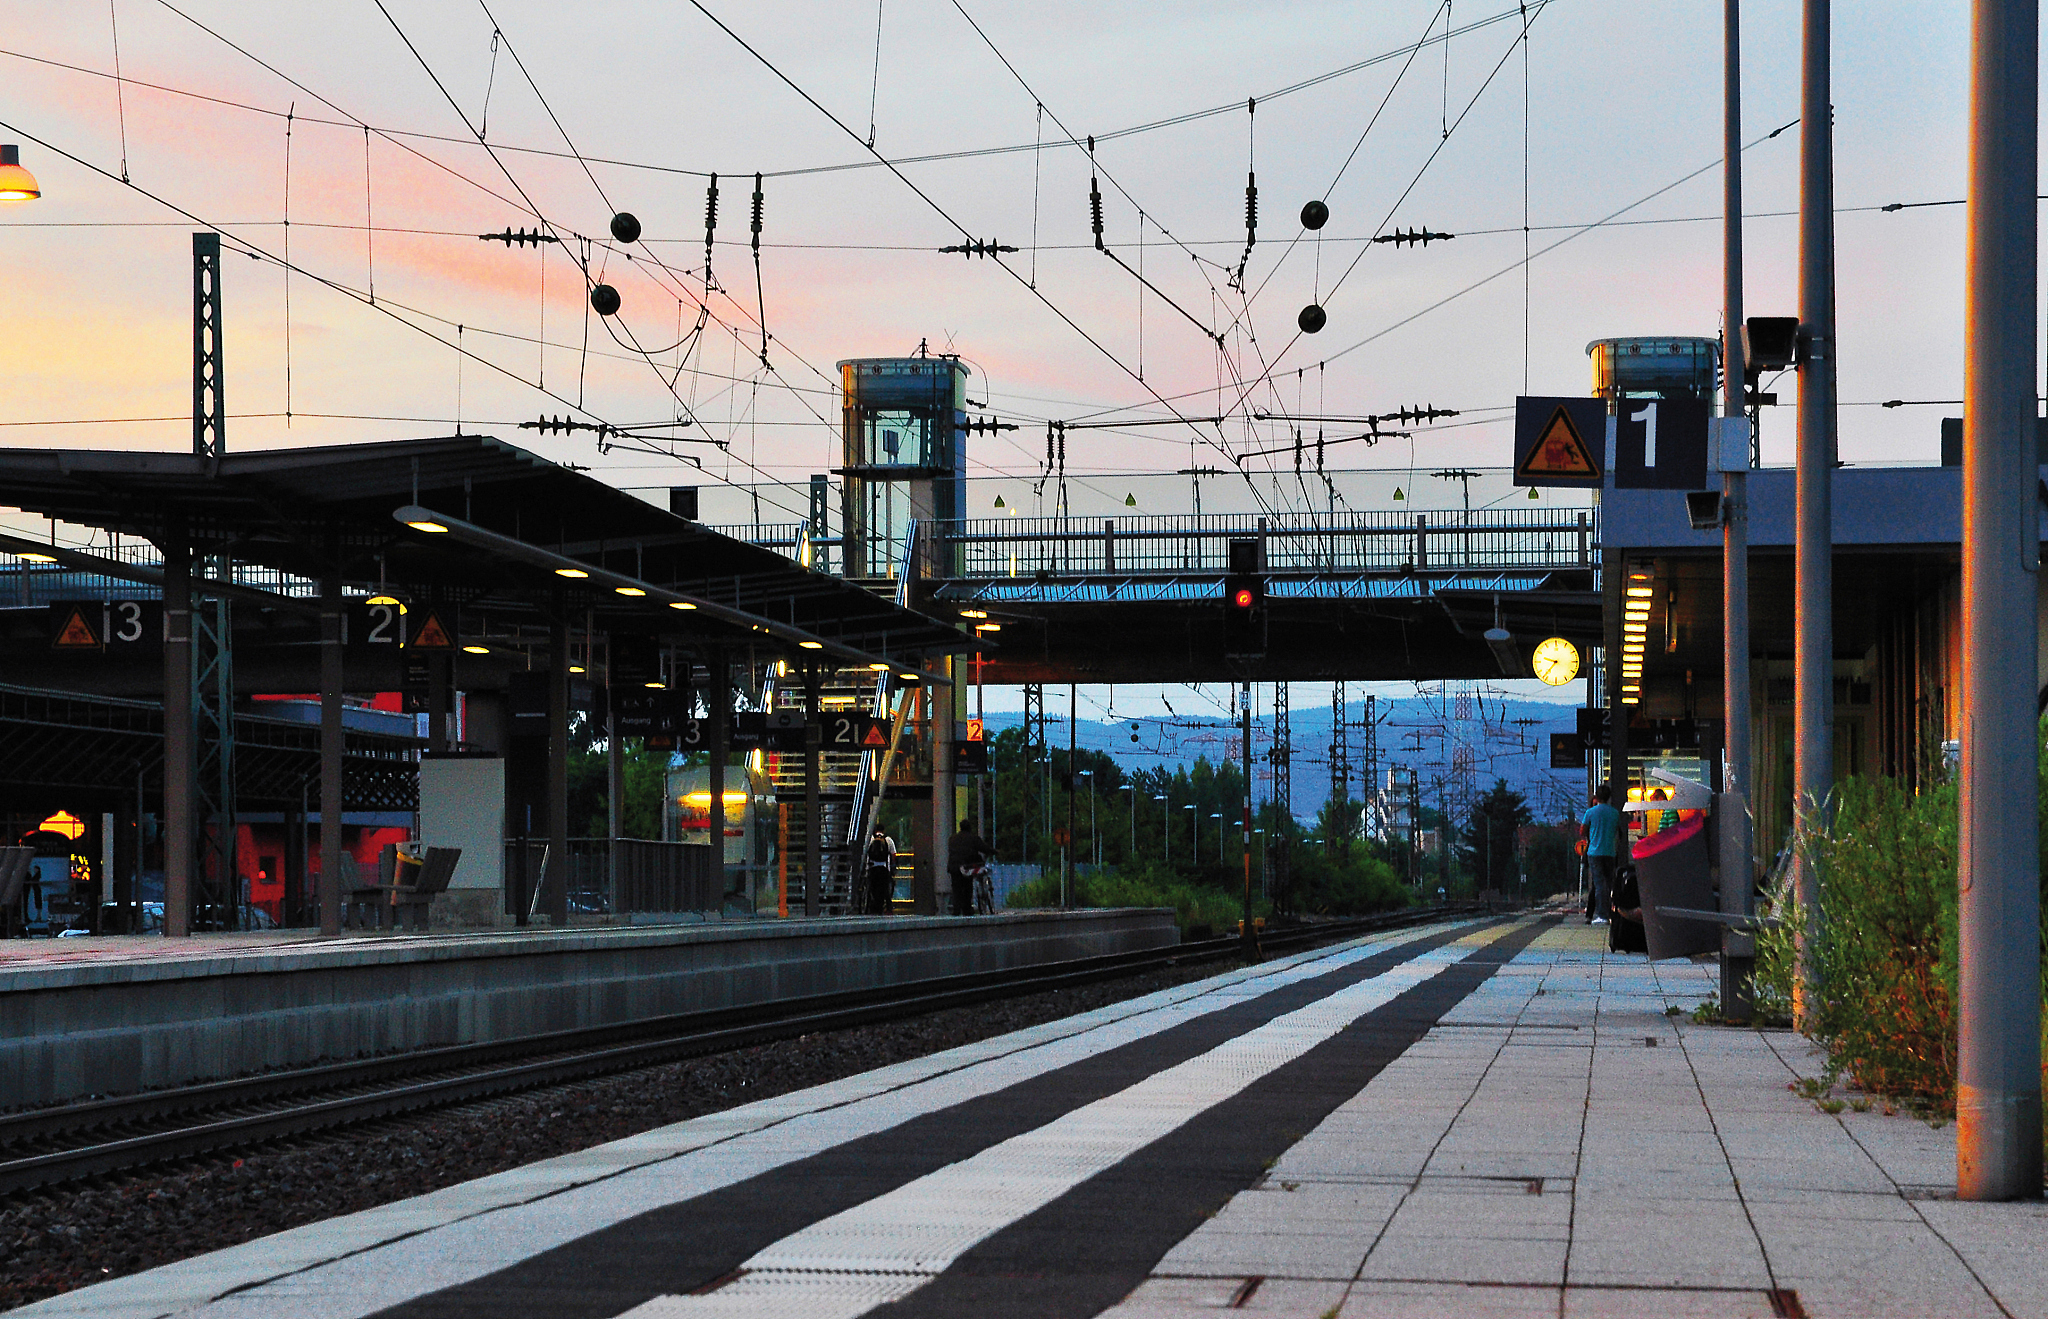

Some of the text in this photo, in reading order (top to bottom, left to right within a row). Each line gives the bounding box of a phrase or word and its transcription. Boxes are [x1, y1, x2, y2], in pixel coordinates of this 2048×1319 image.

[1630, 402, 1657, 467] 1
[116, 601, 143, 642] 3
[367, 604, 393, 643] 2
[621, 716, 652, 726] Ausgang
[1602, 710, 1611, 725] 2
[684, 719, 701, 744] 3
[733, 732, 759, 742] Ausgang
[834, 718, 851, 743] 2
[970, 722, 981, 740] 2
